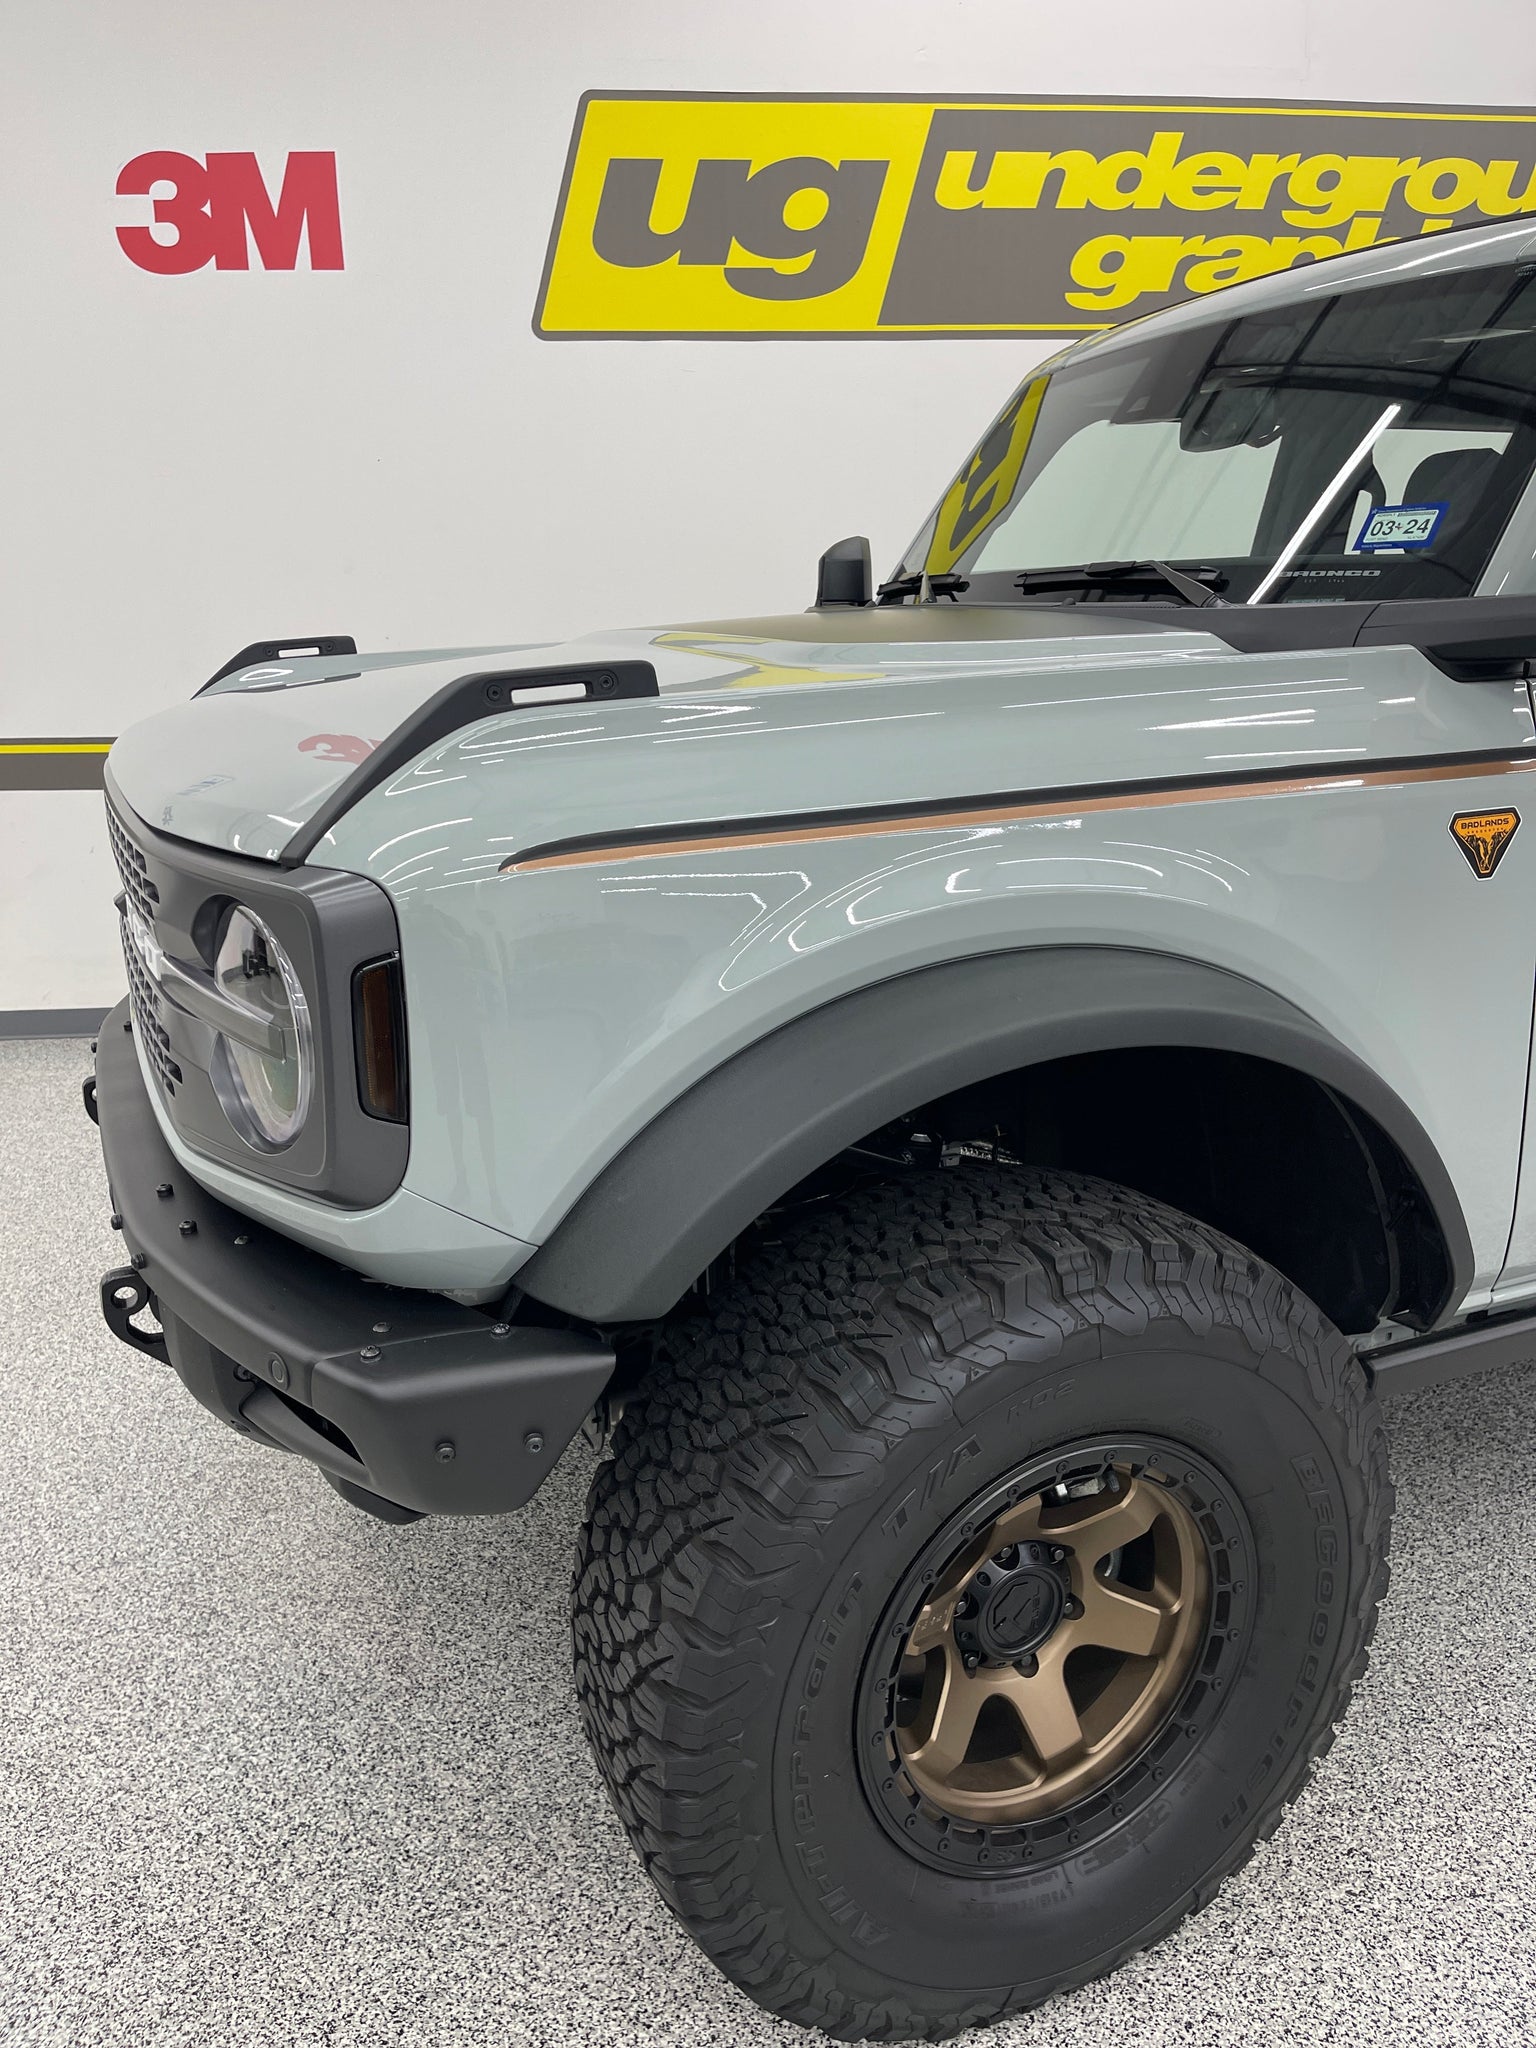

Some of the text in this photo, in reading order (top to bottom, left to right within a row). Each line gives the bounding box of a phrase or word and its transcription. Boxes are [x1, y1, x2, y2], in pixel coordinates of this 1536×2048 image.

[115, 150, 345, 275] 3M
[592, 155, 890, 301] ug
[1370, 518, 1431, 536] 03 24
[1461, 818, 1509, 829] BADLANDS
